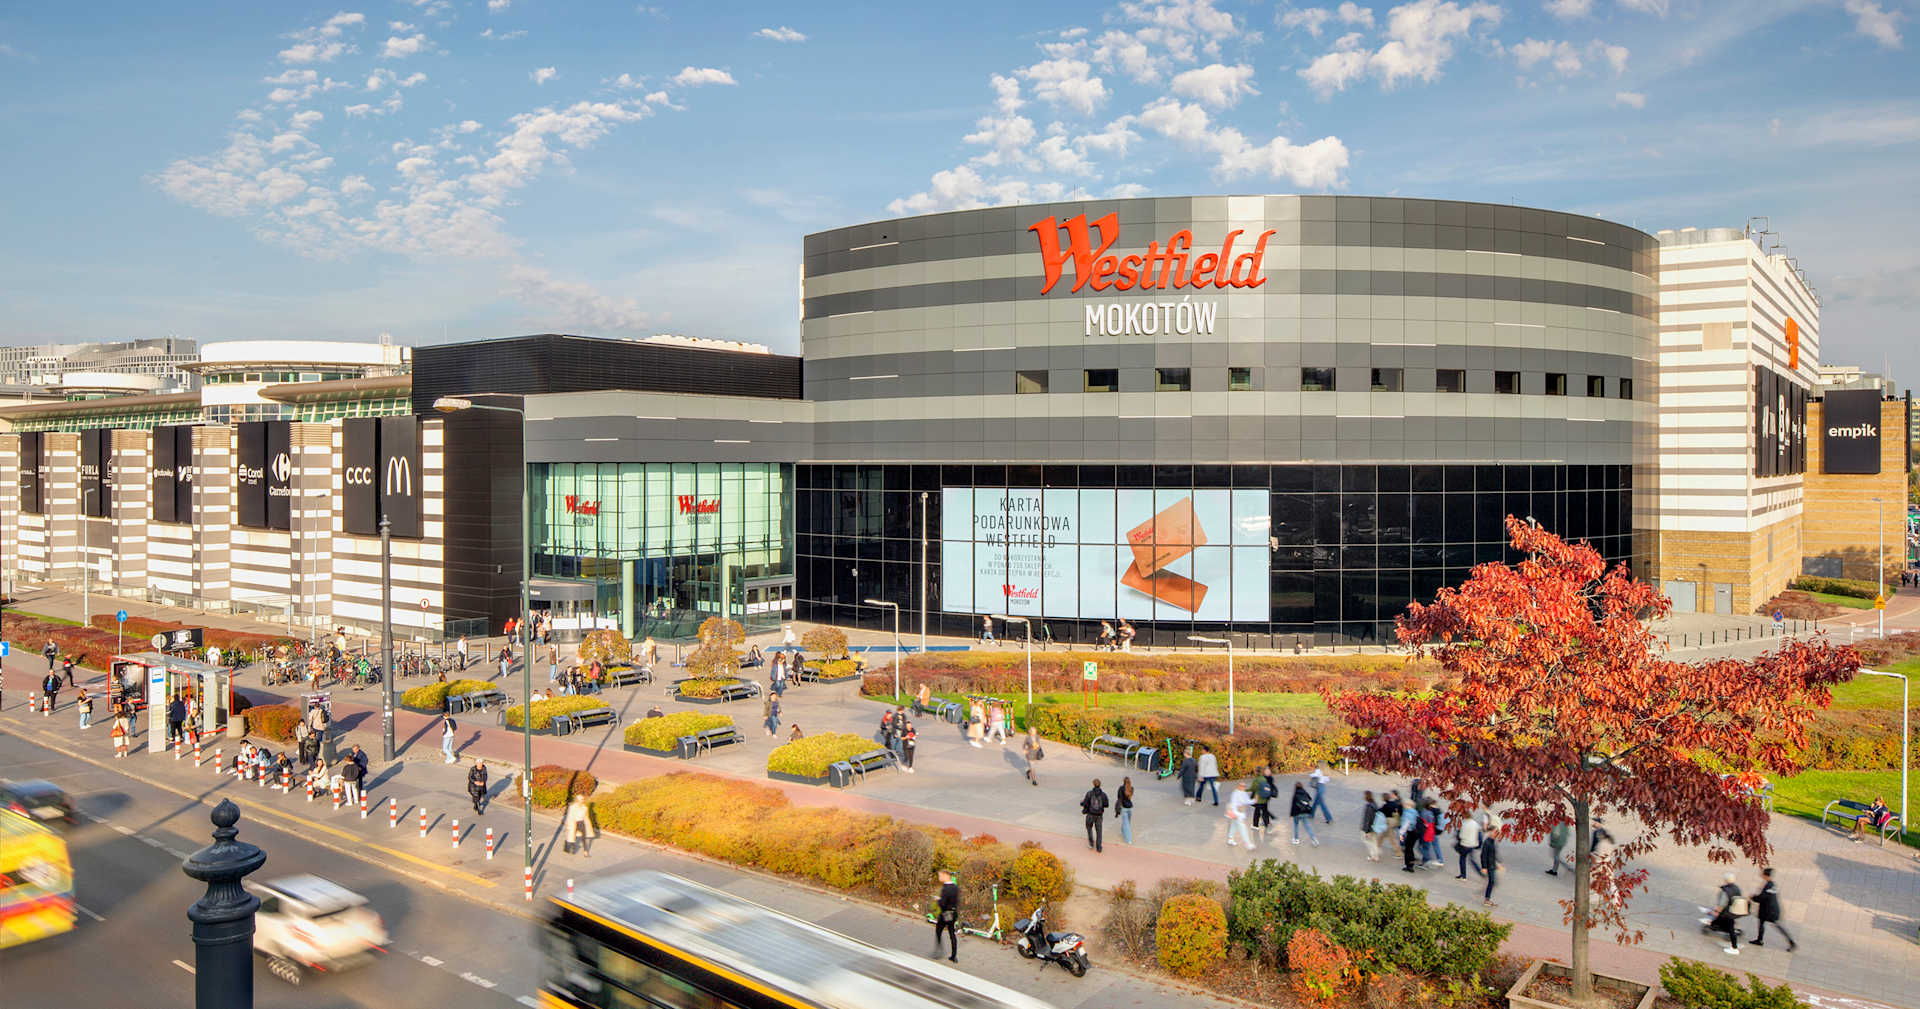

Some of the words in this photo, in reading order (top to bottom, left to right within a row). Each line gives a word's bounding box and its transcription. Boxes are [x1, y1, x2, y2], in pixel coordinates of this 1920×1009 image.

[1028, 212, 1277, 295] Westfield
[1085, 295, 1217, 336] MOKOTÓW
[1828, 423, 1877, 439] empik
[346, 467, 372, 485] CCC
[1000, 497, 1041, 512] KARTA
[973, 514, 1070, 531] PODARUNKOWA
[986, 533, 1056, 549] WETFIED
[1002, 584, 1039, 599] Westfield
